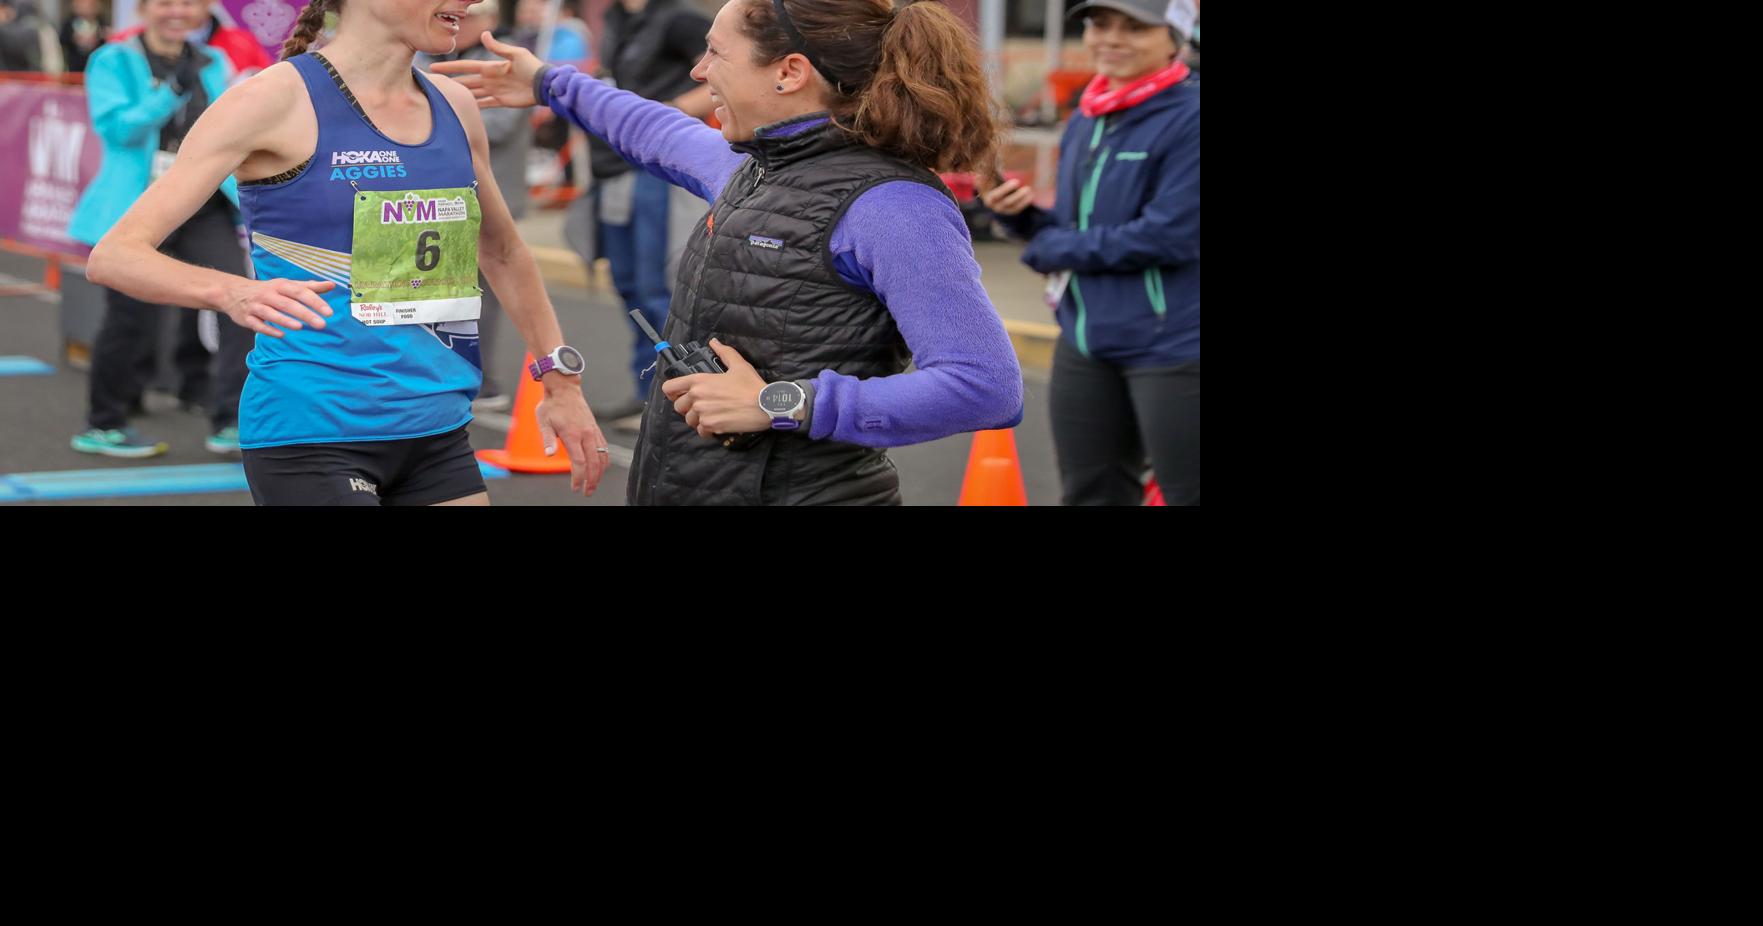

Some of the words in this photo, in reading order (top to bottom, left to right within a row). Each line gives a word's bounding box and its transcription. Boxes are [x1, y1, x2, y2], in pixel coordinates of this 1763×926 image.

[331, 150, 381, 165] HOKA
[330, 165, 407, 181] AGGIES
[415, 230, 440, 271] 6
